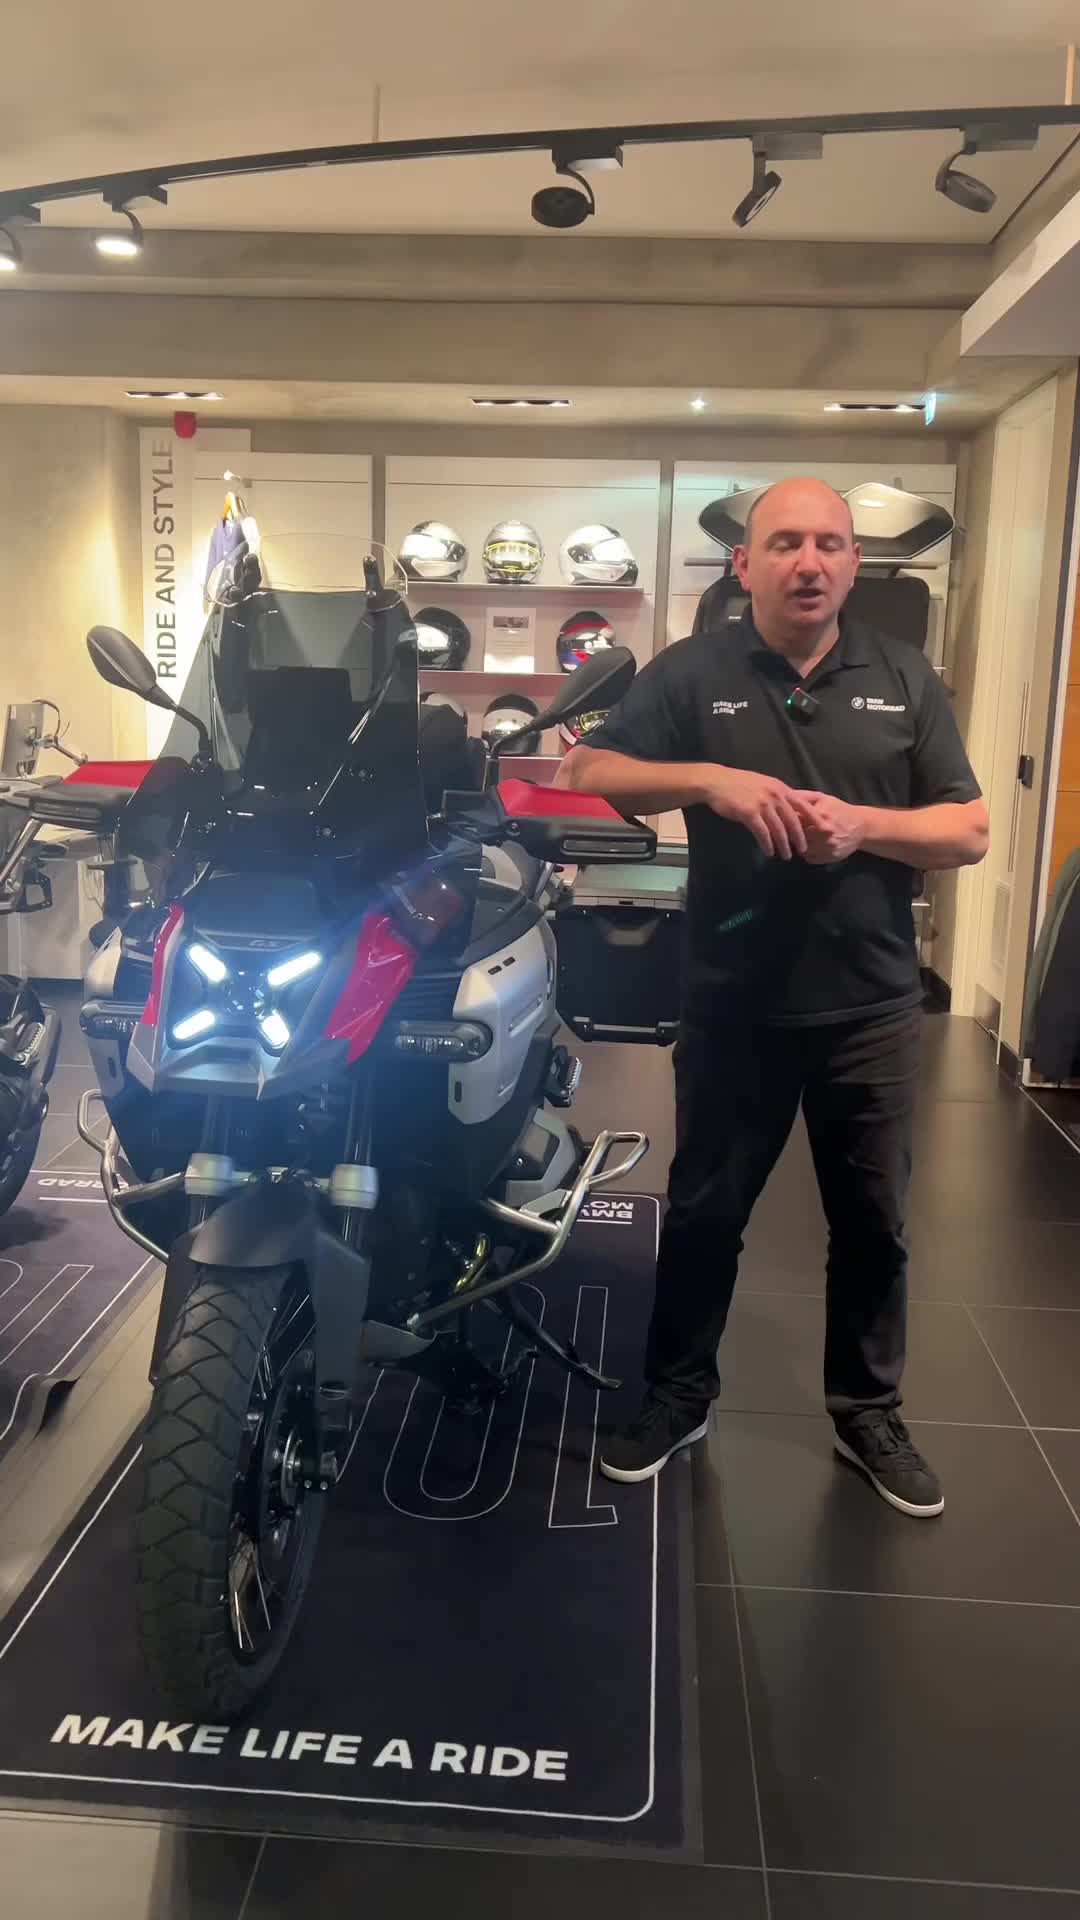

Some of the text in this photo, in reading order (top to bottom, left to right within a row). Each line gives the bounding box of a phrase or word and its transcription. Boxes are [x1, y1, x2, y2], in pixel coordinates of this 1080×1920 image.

[152, 440, 177, 678] RIDE AND STYLE
[733, 701, 748, 709] LIFE
[49, 1713, 569, 1782] MAKE LIFE A RIDE
